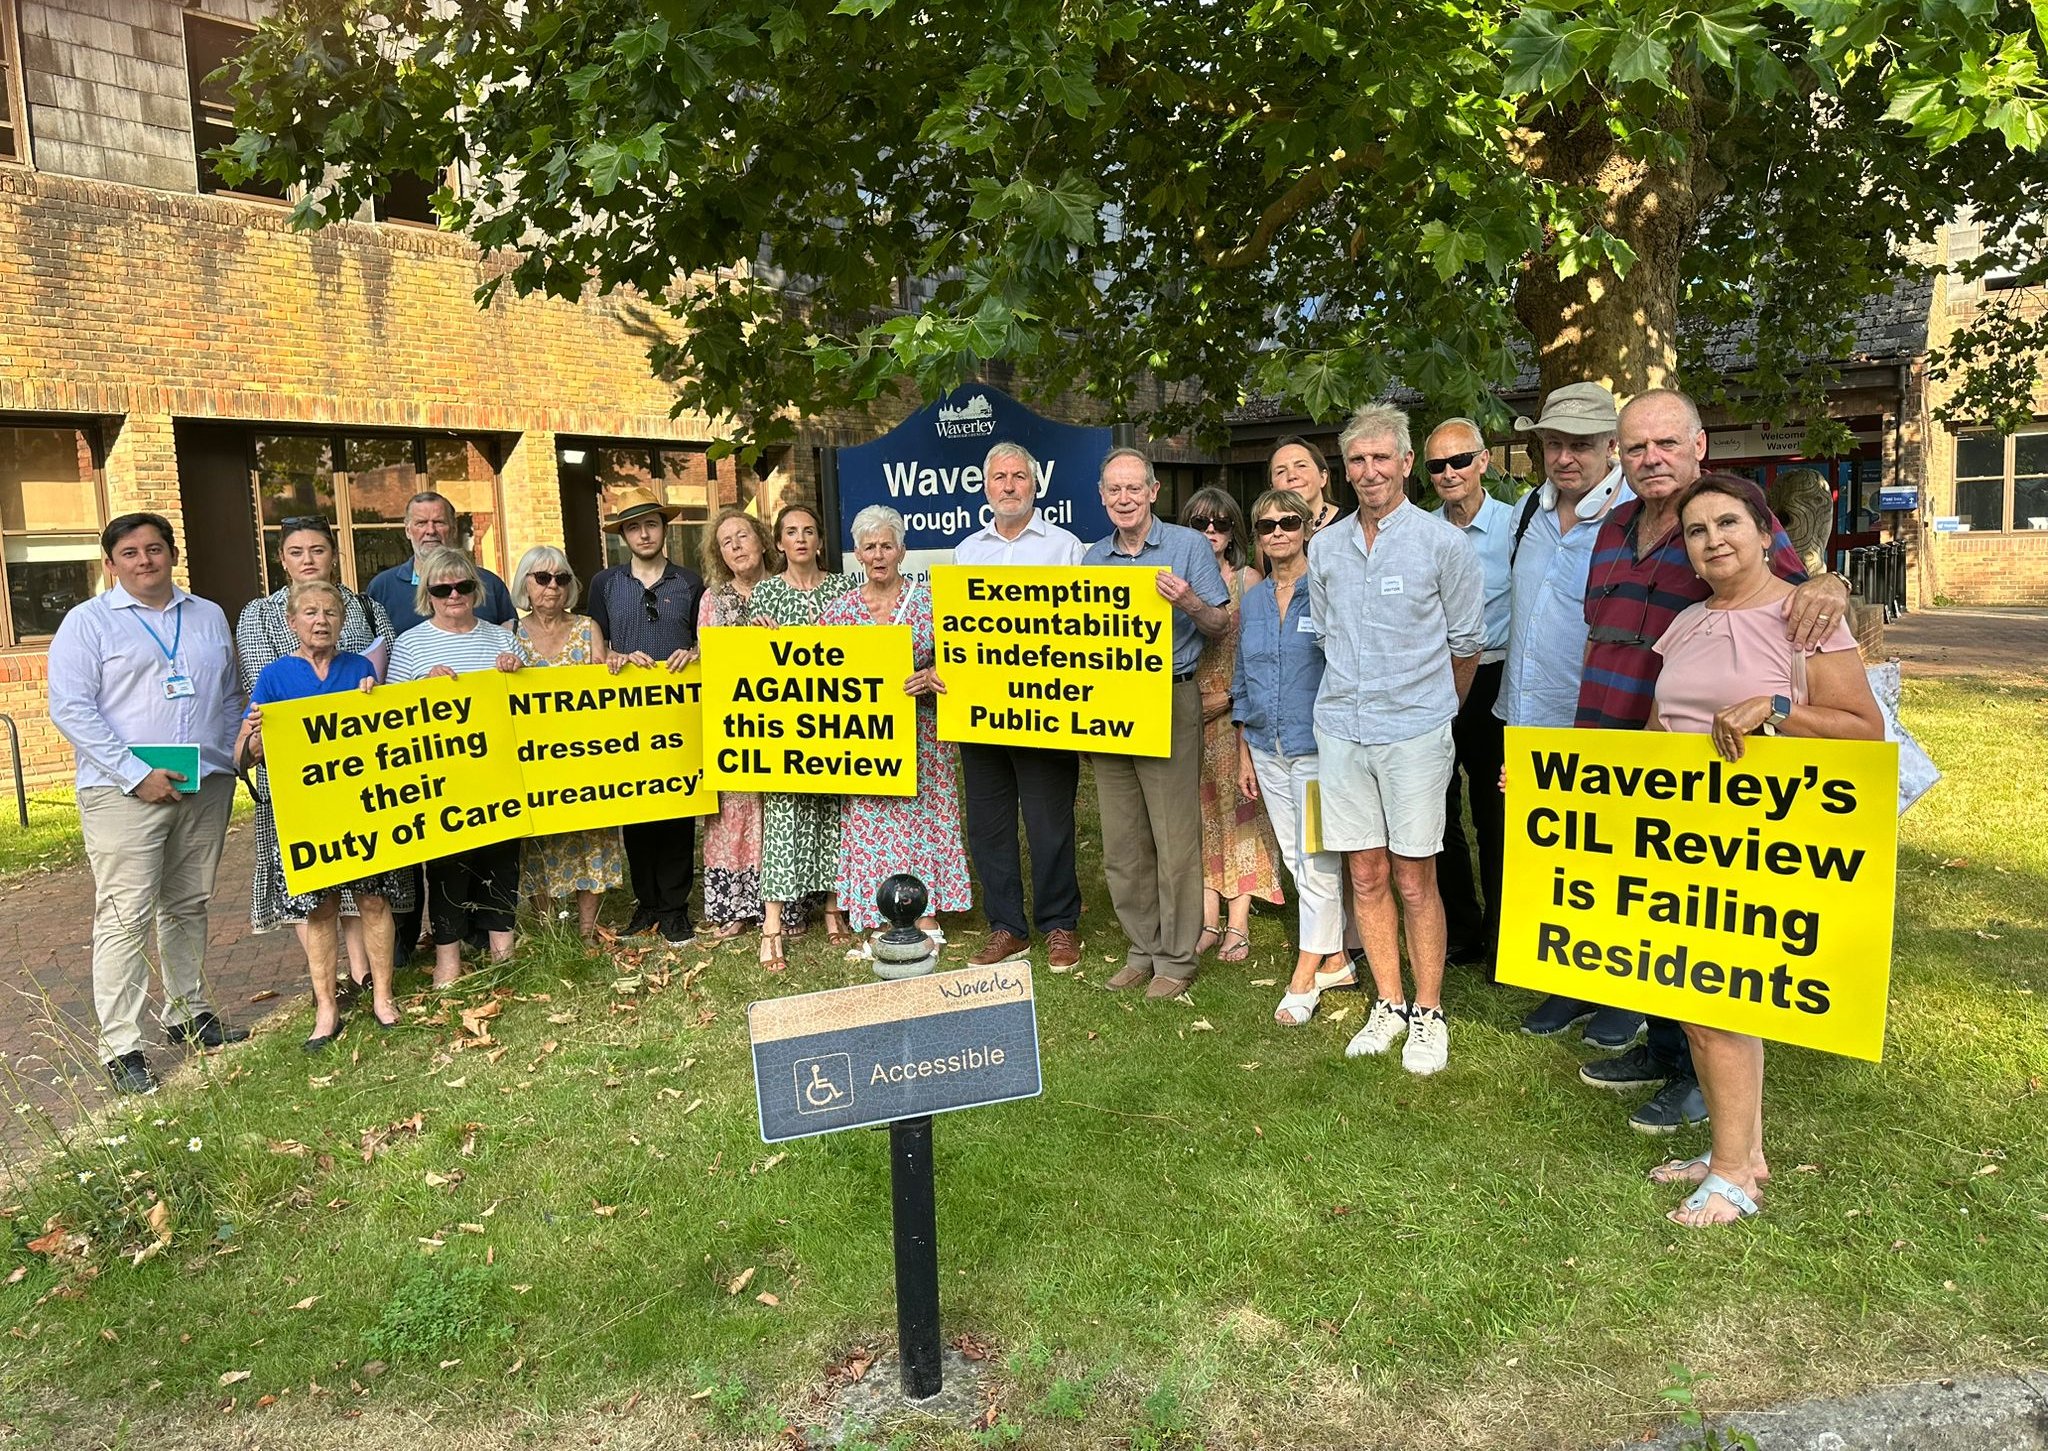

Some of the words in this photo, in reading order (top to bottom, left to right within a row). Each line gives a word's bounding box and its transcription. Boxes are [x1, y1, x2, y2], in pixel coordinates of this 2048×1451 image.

[934, 420, 997, 437] Waverley
[1761, 431, 1806, 441] Welcome
[883, 459, 1056, 499] Wavey
[904, 506, 971, 535] rough
[978, 500, 1072, 528] Ccil
[968, 579, 1130, 609] Exempting
[943, 613, 1162, 644] accountability
[770, 641, 845, 667] Vote
[943, 643, 967, 663] is
[977, 643, 1163, 673] indefensible
[509, 682, 702, 716] NTRAPMENT
[732, 677, 884, 703] AGAINST
[1008, 678, 1094, 702] under
[302, 696, 472, 744] Waverley
[723, 713, 785, 739] this
[796, 713, 894, 740] SHAM
[970, 706, 1060, 733] Public
[1071, 711, 1135, 738] Law
[301, 756, 365, 786] are
[374, 731, 489, 771] failing
[517, 731, 640, 763] dressed
[650, 732, 684, 750] as
[717, 748, 772, 774] CIL
[783, 749, 903, 777] Review
[360, 773, 446, 813] their
[527, 768, 704, 809] ureaucracy’
[1531, 750, 1858, 821] Waverley’s
[289, 830, 379, 872] Duty
[391, 812, 426, 845] of
[439, 798, 522, 833] Care
[1526, 807, 1613, 855] CIL
[1635, 816, 1866, 882] Review
[1552, 867, 1595, 911] is
[1616, 874, 1820, 957] Failing
[1537, 921, 1831, 1015] Residents
[939, 972, 1023, 998] Waverley
[869, 1045, 1005, 1085] Accessible
